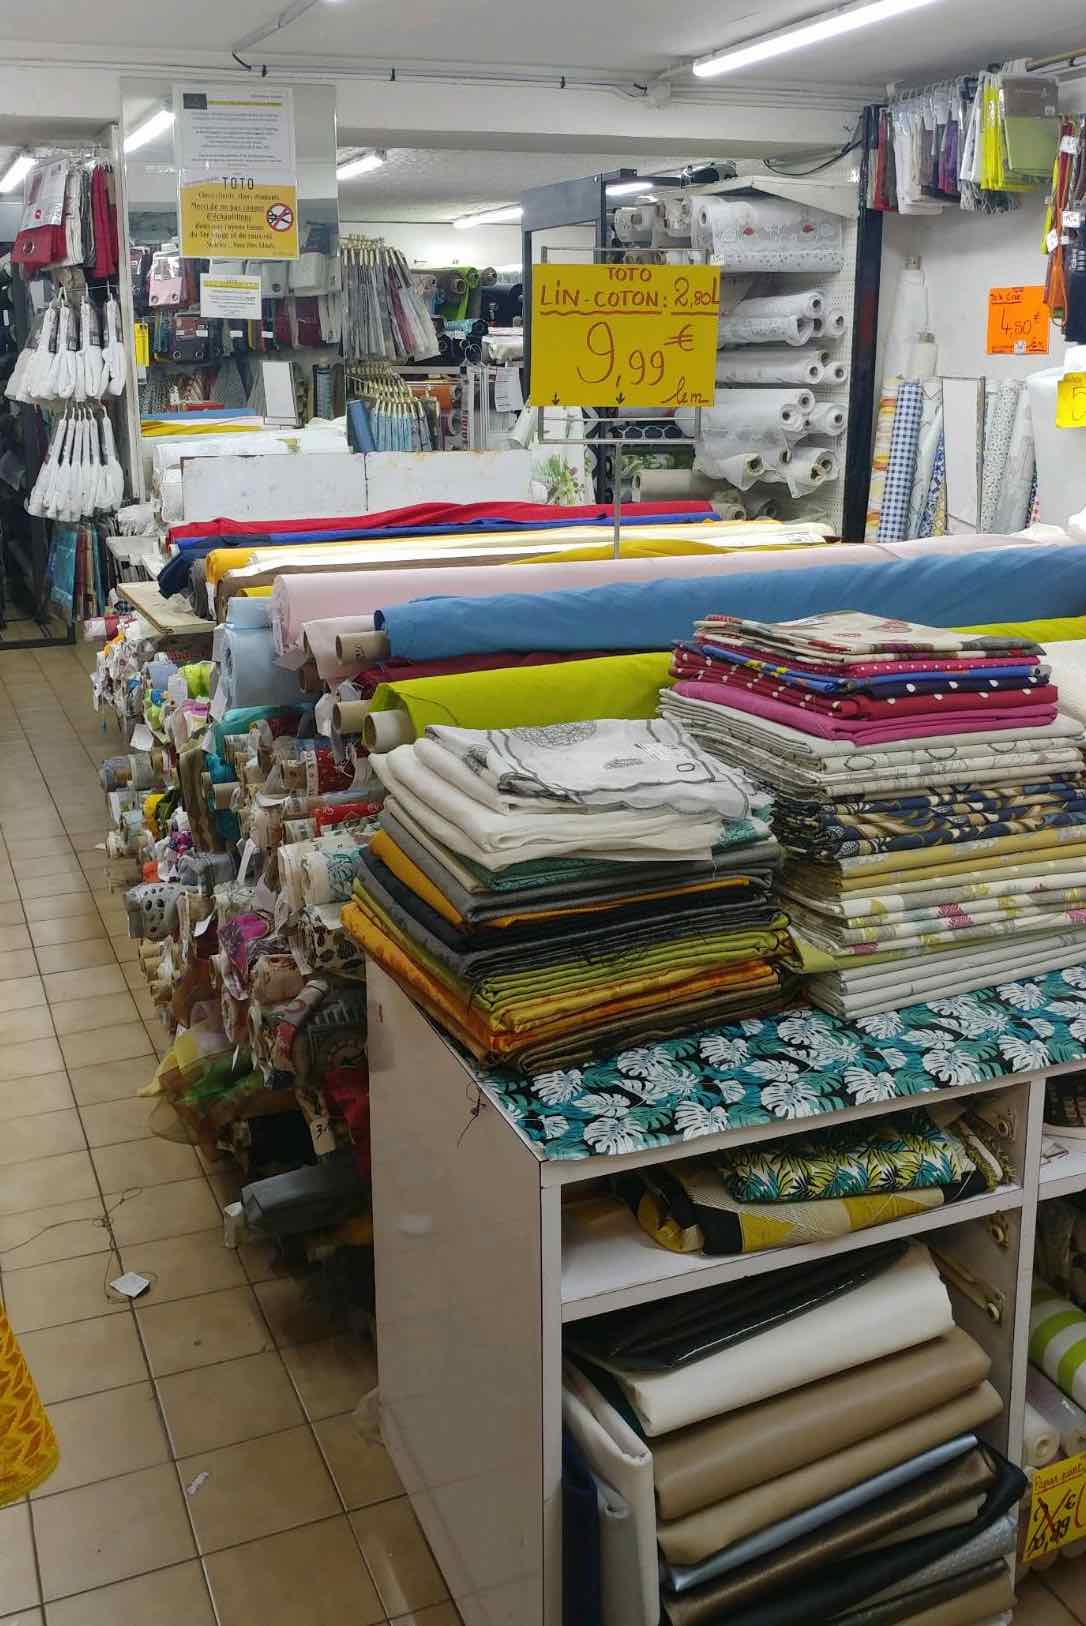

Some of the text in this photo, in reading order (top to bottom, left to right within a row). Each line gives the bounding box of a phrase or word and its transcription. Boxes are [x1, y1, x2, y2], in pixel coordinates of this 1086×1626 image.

[222, 177, 254, 190] TOTO
[608, 267, 652, 281] TOTO
[577, 322, 664, 387] 9,99
